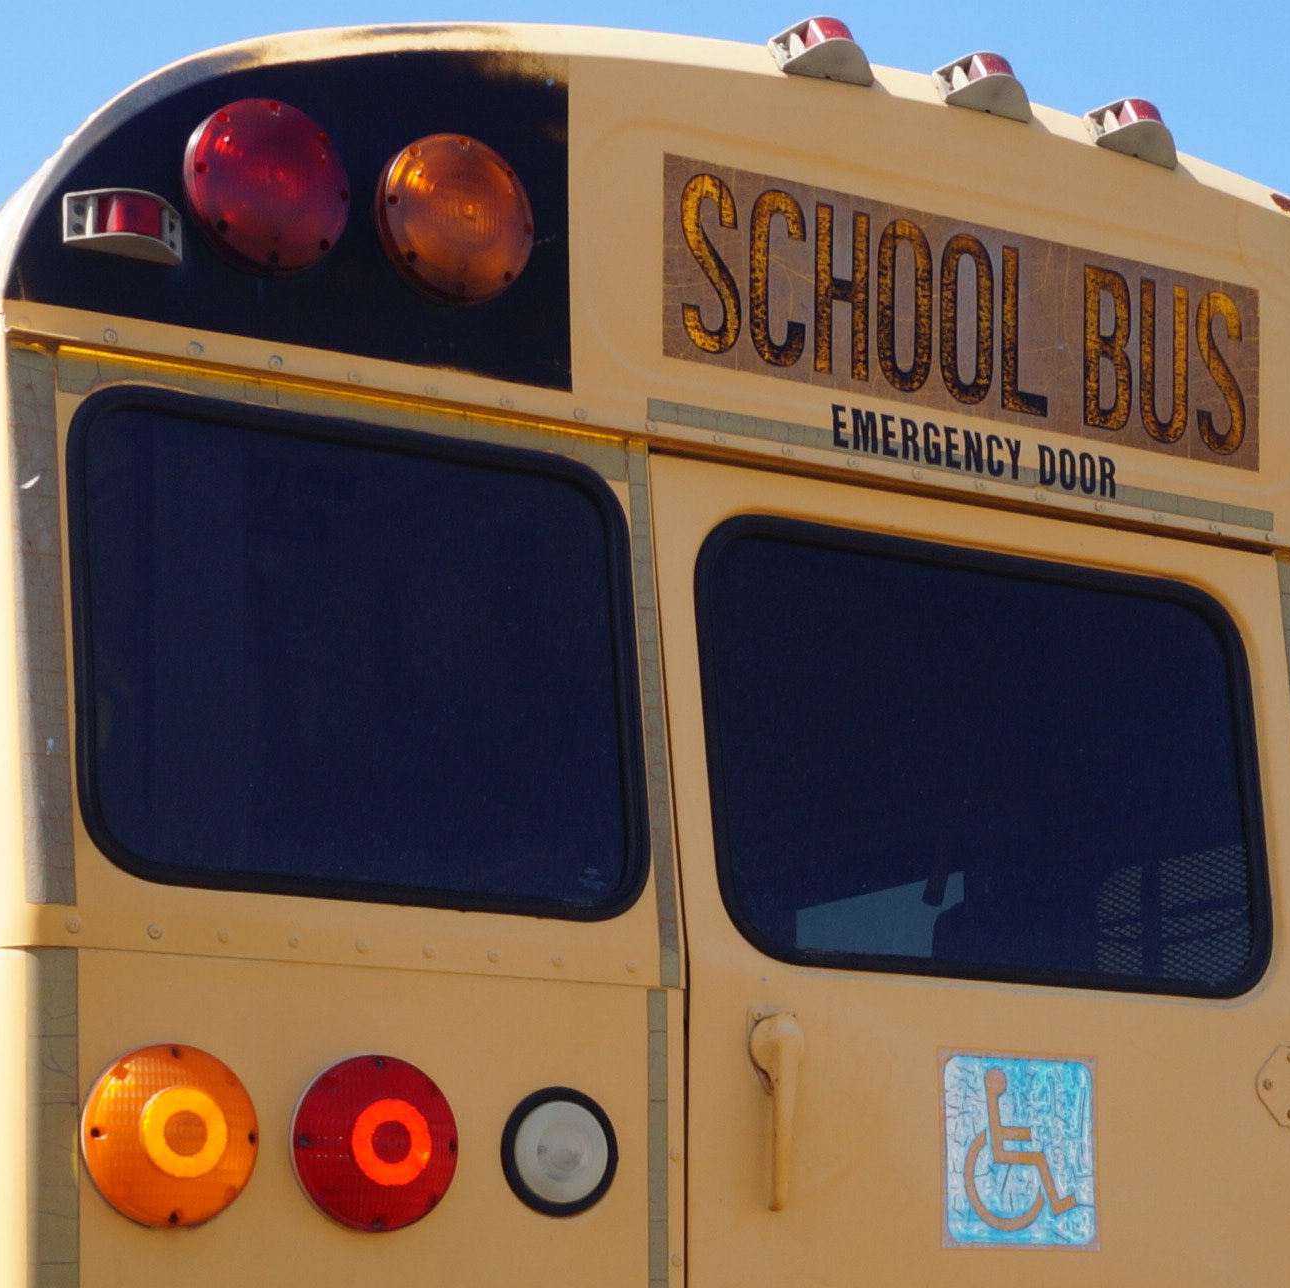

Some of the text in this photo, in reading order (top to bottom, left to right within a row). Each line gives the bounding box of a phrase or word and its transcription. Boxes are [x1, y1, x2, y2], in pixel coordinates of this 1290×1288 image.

[680, 173, 1246, 455] SCHOOL BUS
[831, 403, 1117, 500] EMERGENCY DOOR
